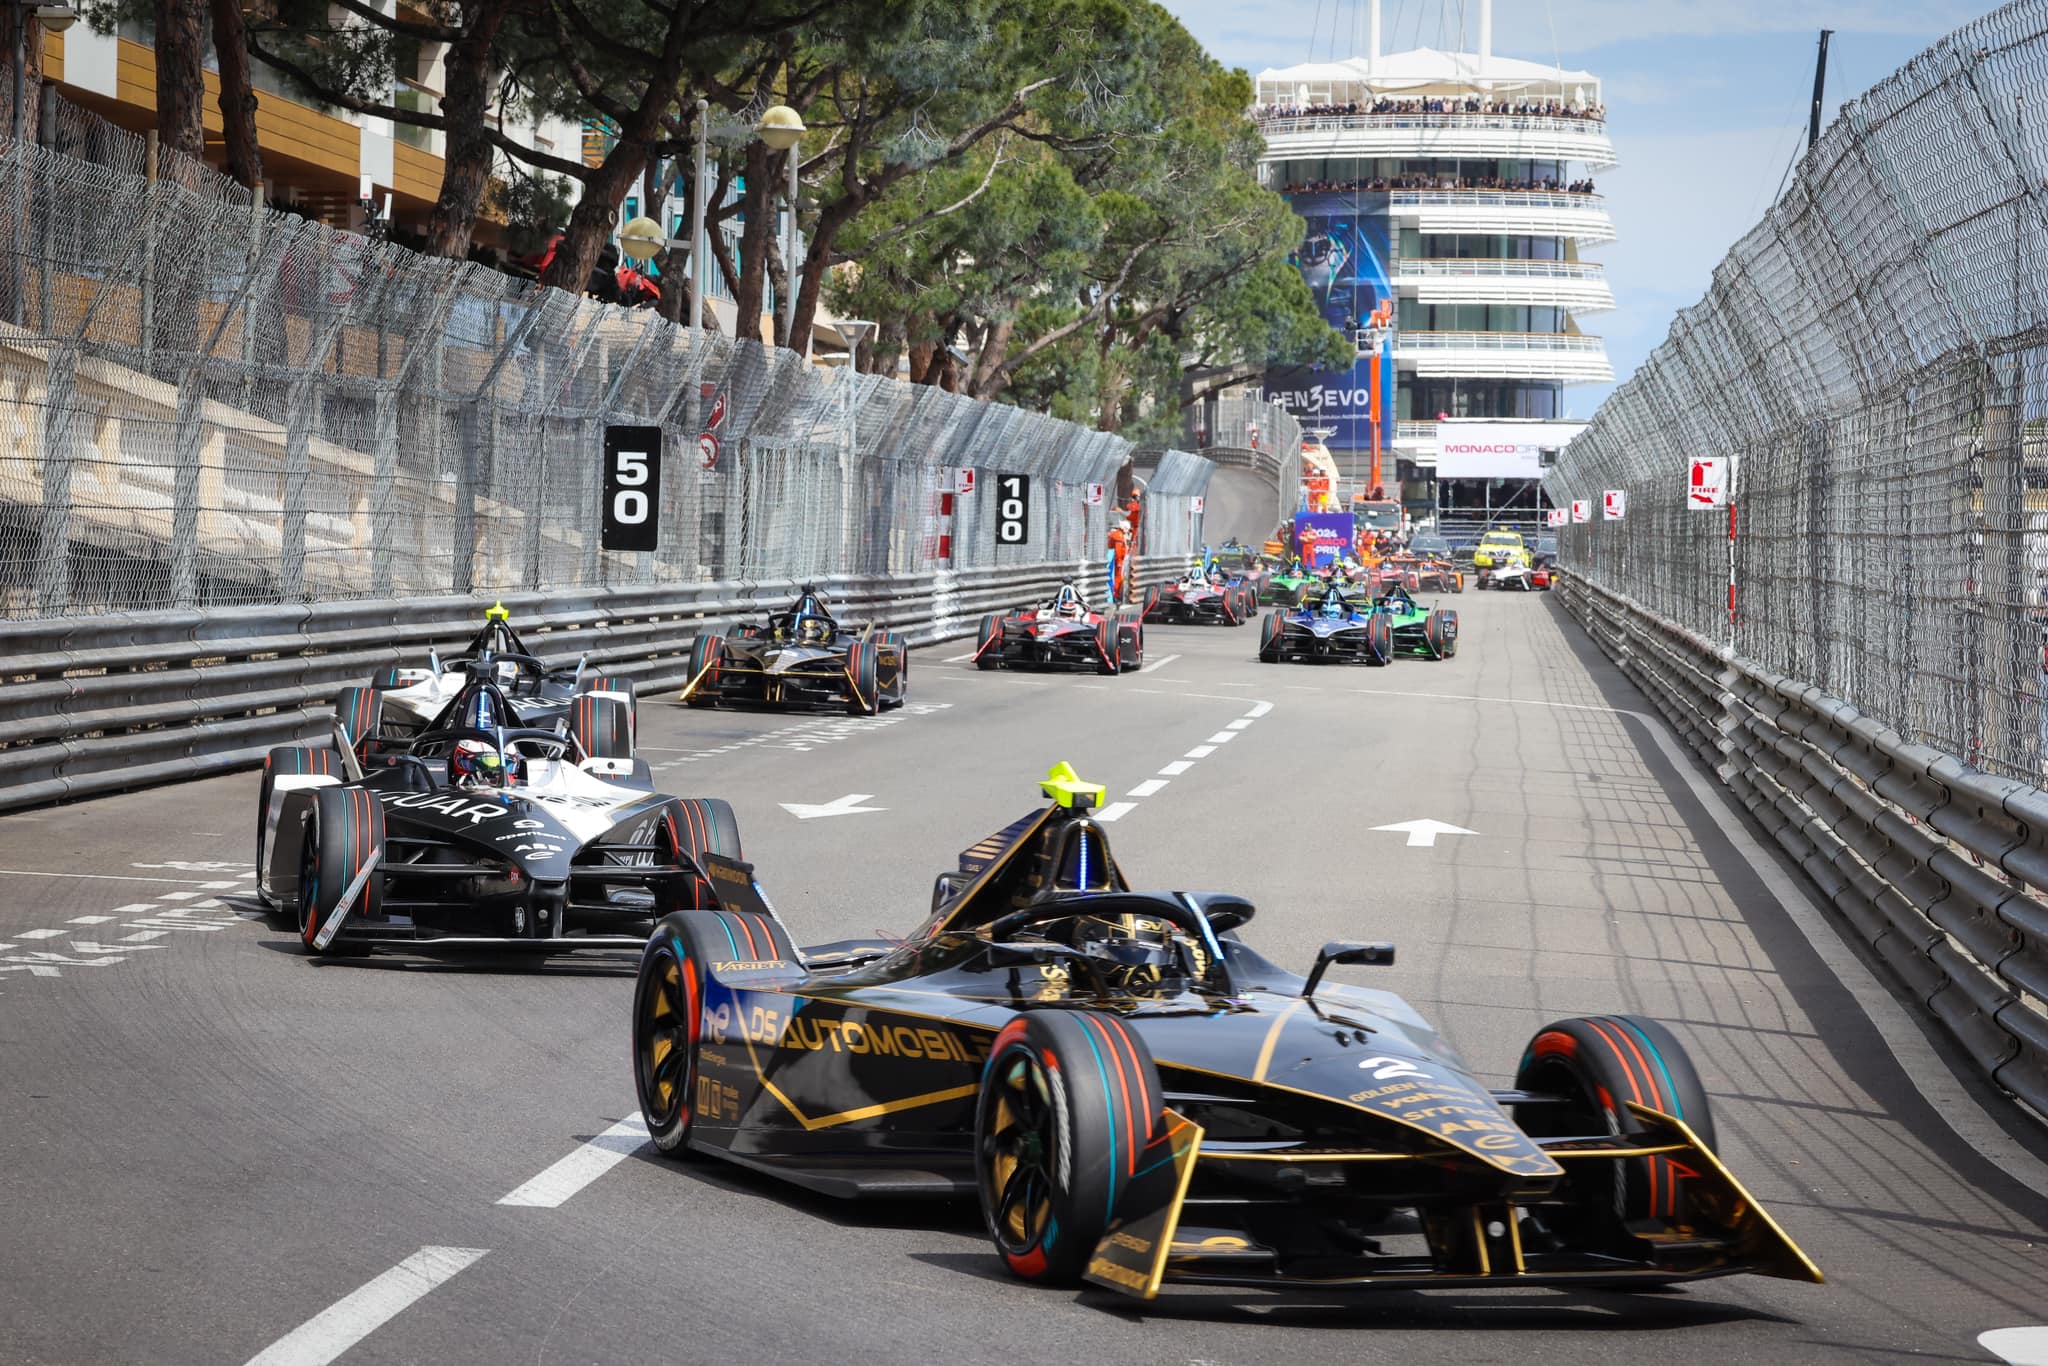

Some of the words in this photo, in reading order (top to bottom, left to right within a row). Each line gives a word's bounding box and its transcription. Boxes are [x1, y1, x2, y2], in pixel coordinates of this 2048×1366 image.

[614, 451, 649, 524] 50
[1001, 477, 1024, 541] 100
[1358, 1057, 1433, 1080] 2
